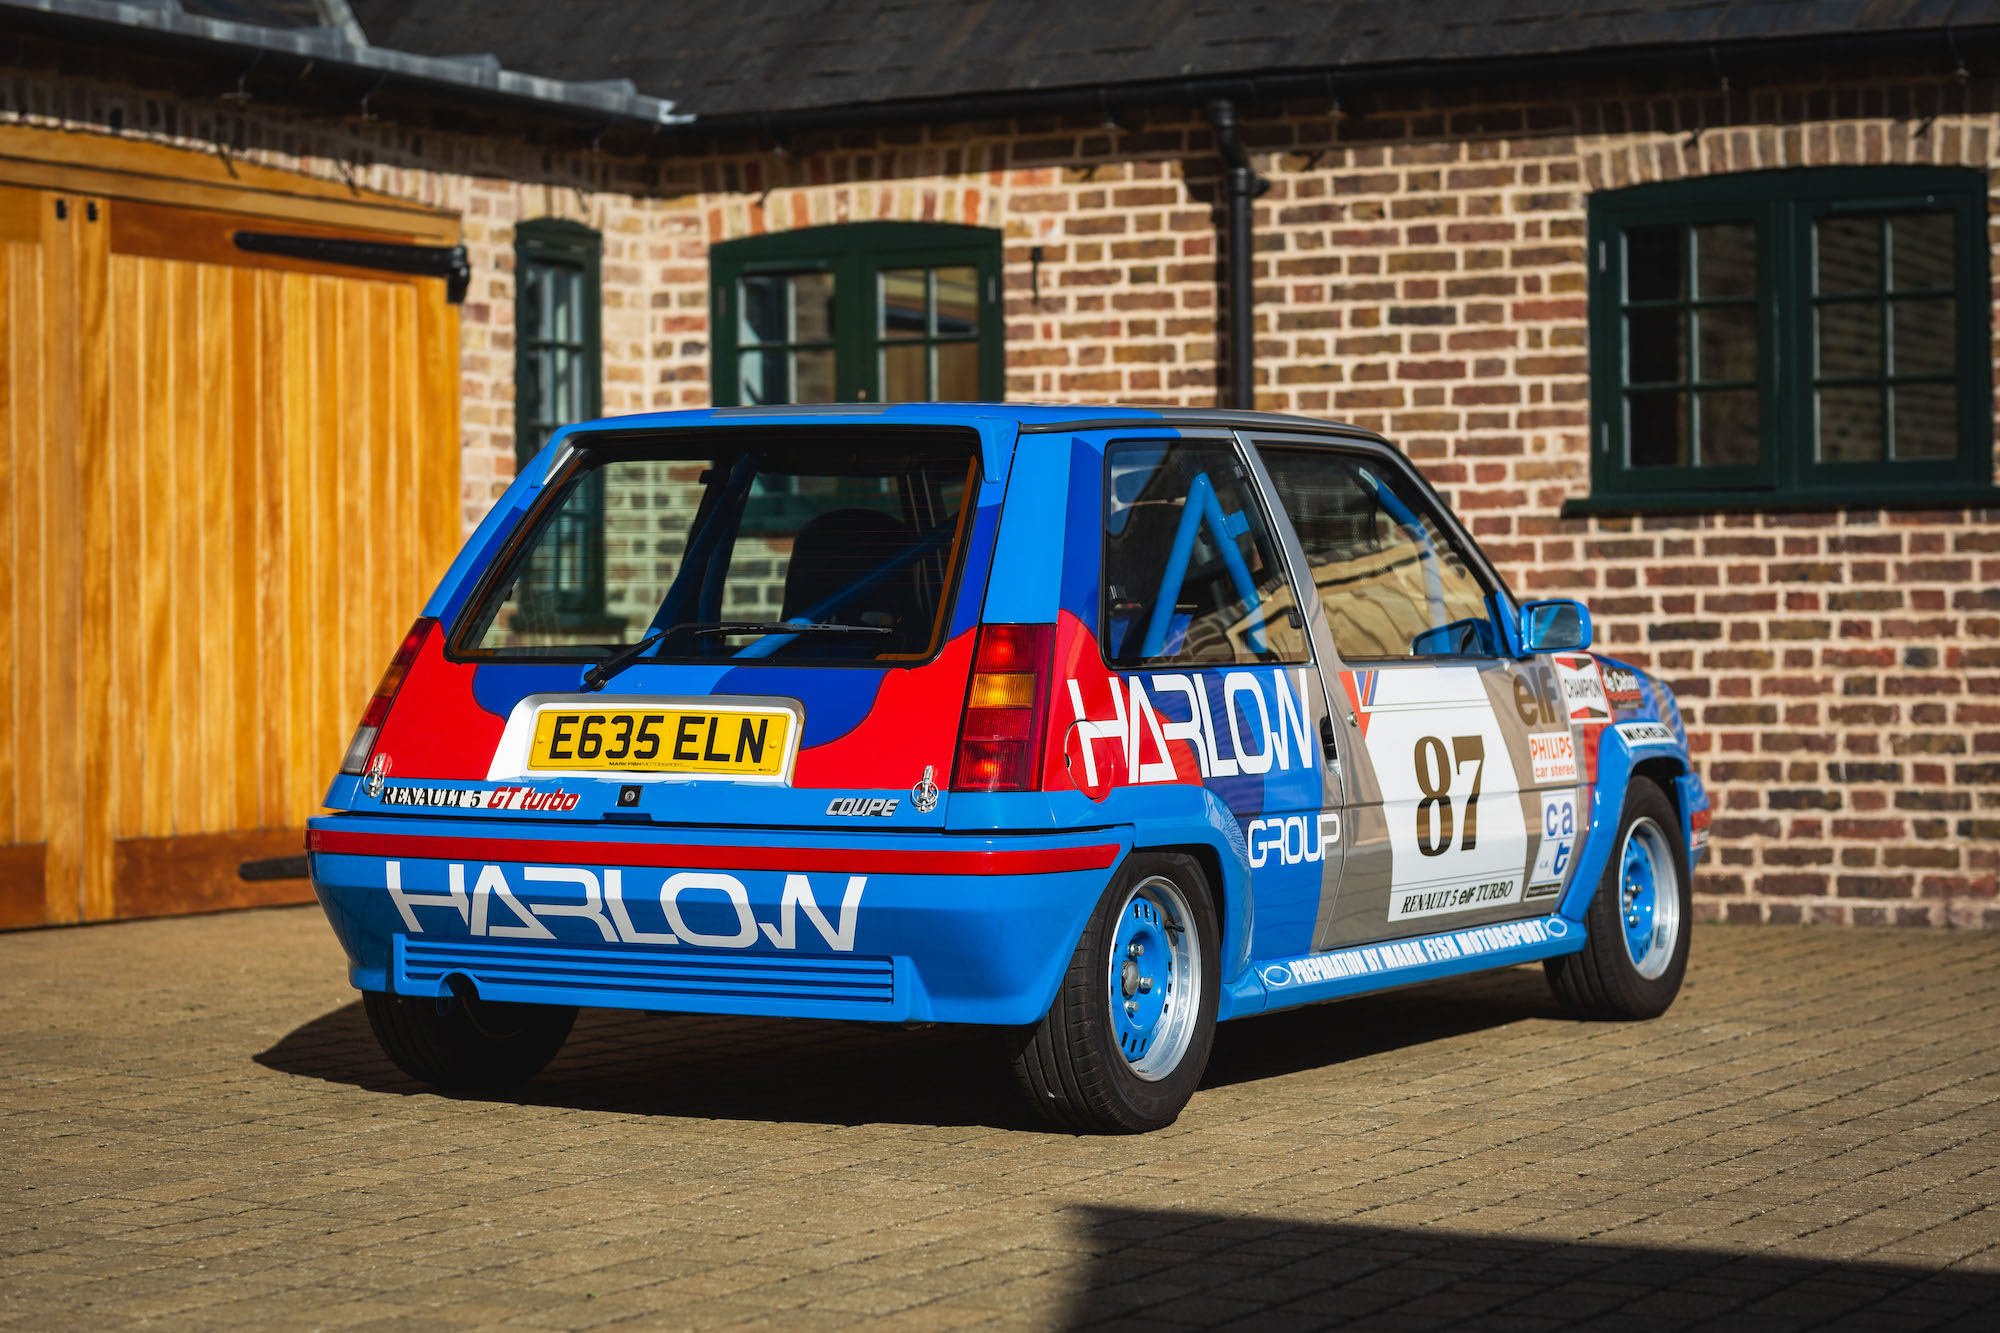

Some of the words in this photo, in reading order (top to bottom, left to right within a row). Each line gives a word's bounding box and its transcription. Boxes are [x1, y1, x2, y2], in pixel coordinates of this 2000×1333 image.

[1513, 666, 1558, 727] elf
[1564, 678, 1603, 698] CHAMPION
[549, 715, 665, 760] E635
[673, 716, 769, 763] ELN
[1066, 667, 1313, 787] HARLON
[1621, 726, 1673, 741] MICHELIN
[1530, 736, 1573, 760] PHILIPS
[1535, 767, 1548, 778] car
[1551, 764, 1575, 777] stereo
[380, 786, 466, 808] RENAULT
[469, 789, 483, 808] 5
[487, 786, 523, 809] GT
[520, 787, 580, 811] turbo
[825, 797, 900, 817] COUPE
[1414, 735, 1485, 857] 87
[1248, 813, 1340, 869] GROUP
[385, 861, 868, 952] HARLON
[1401, 889, 1450, 914] RENAULT
[1449, 889, 1459, 907] 5
[1459, 886, 1477, 906] elf
[1475, 880, 1514, 902] TURBO
[1288, 950, 1369, 984] PREPARATION
[1361, 948, 1383, 972] BY
[1378, 941, 1429, 969] MARK
[1422, 935, 1461, 961] FISH
[1454, 920, 1547, 955] MOTORSPORT
